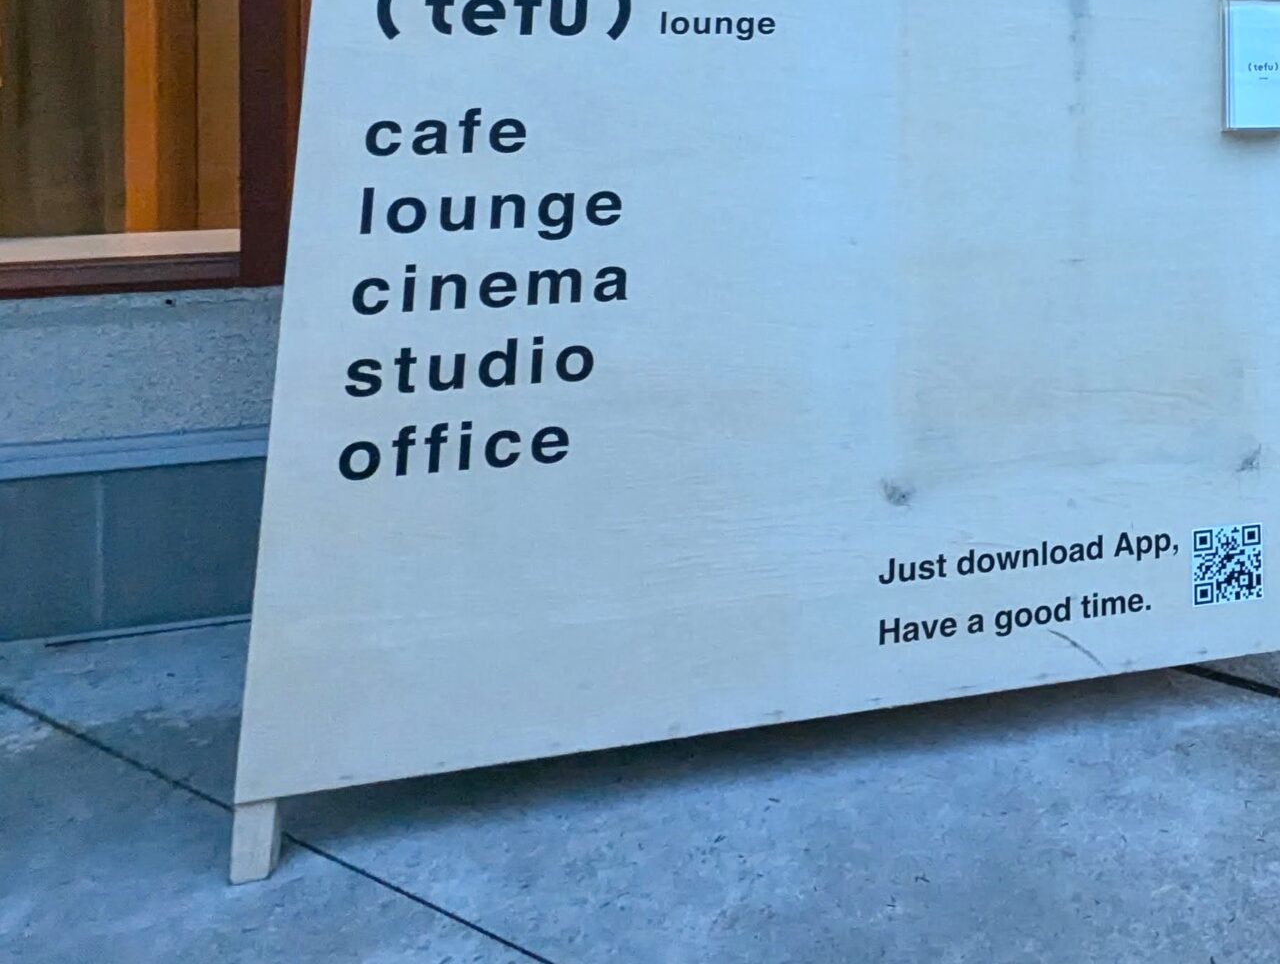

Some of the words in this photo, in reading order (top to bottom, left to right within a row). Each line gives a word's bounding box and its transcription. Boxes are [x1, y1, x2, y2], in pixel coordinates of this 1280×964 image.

[660, 11, 776, 41] lounge
[1248, 61, 1279, 72] (tefu)
[365, 107, 527, 157] cafe
[359, 187, 623, 241] lounge
[352, 264, 628, 315] cinema
[345, 336, 594, 397] studio
[338, 420, 570, 481] office
[878, 553, 947, 585] Just
[956, 535, 1103, 575] download
[1113, 532, 1180, 561] App,
[878, 614, 957, 645] Have
[967, 614, 984, 633] a
[995, 597, 1071, 636] good
[1080, 591, 1152, 619] time.
